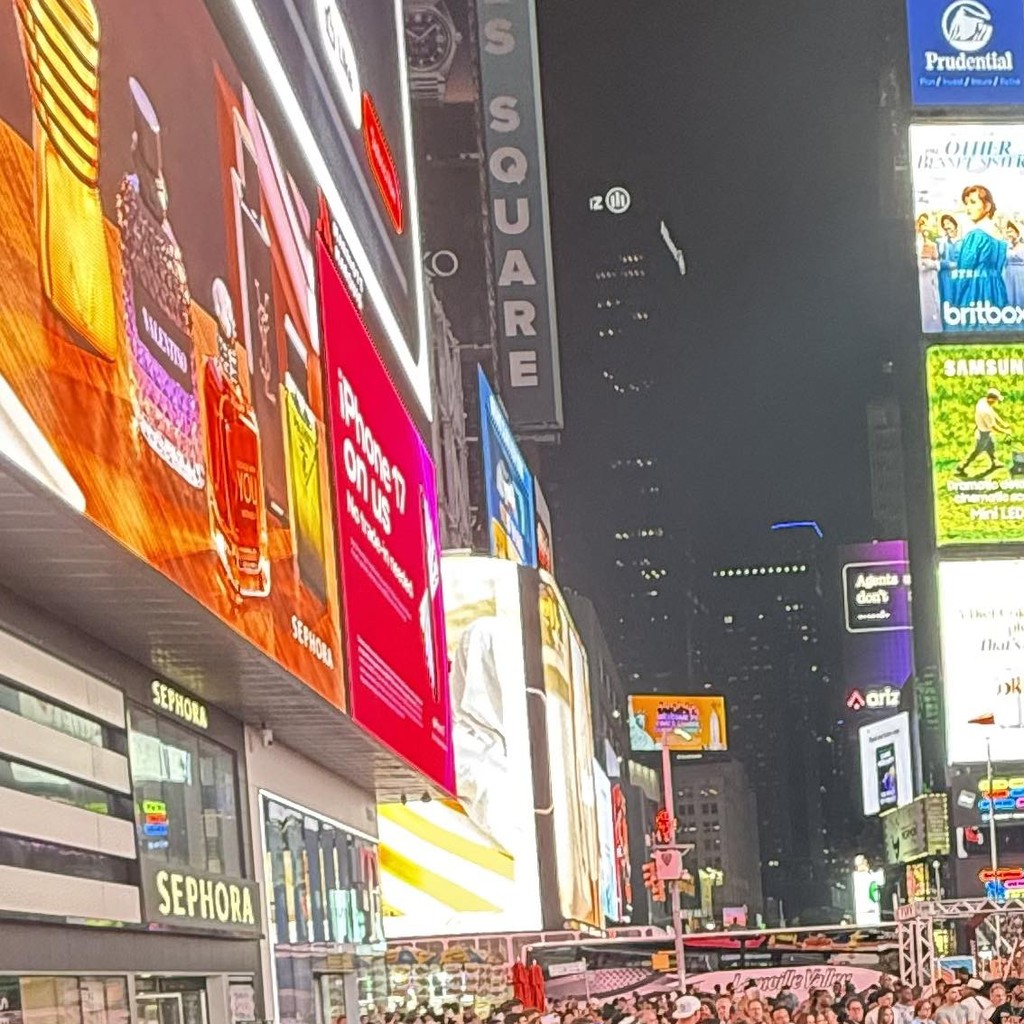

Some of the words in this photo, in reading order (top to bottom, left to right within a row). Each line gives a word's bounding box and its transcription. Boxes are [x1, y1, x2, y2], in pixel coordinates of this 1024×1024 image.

[925, 51, 1014, 72] Prudential
[488, 96, 540, 387] SQUARE
[337, 366, 392, 494] iPhone
[370, 478, 392, 536] us
[855, 574, 899, 589] Agents
[291, 614, 334, 670] SEPHORA
[152, 680, 208, 729] SEPHORA
[157, 870, 254, 924] SEPHORA
